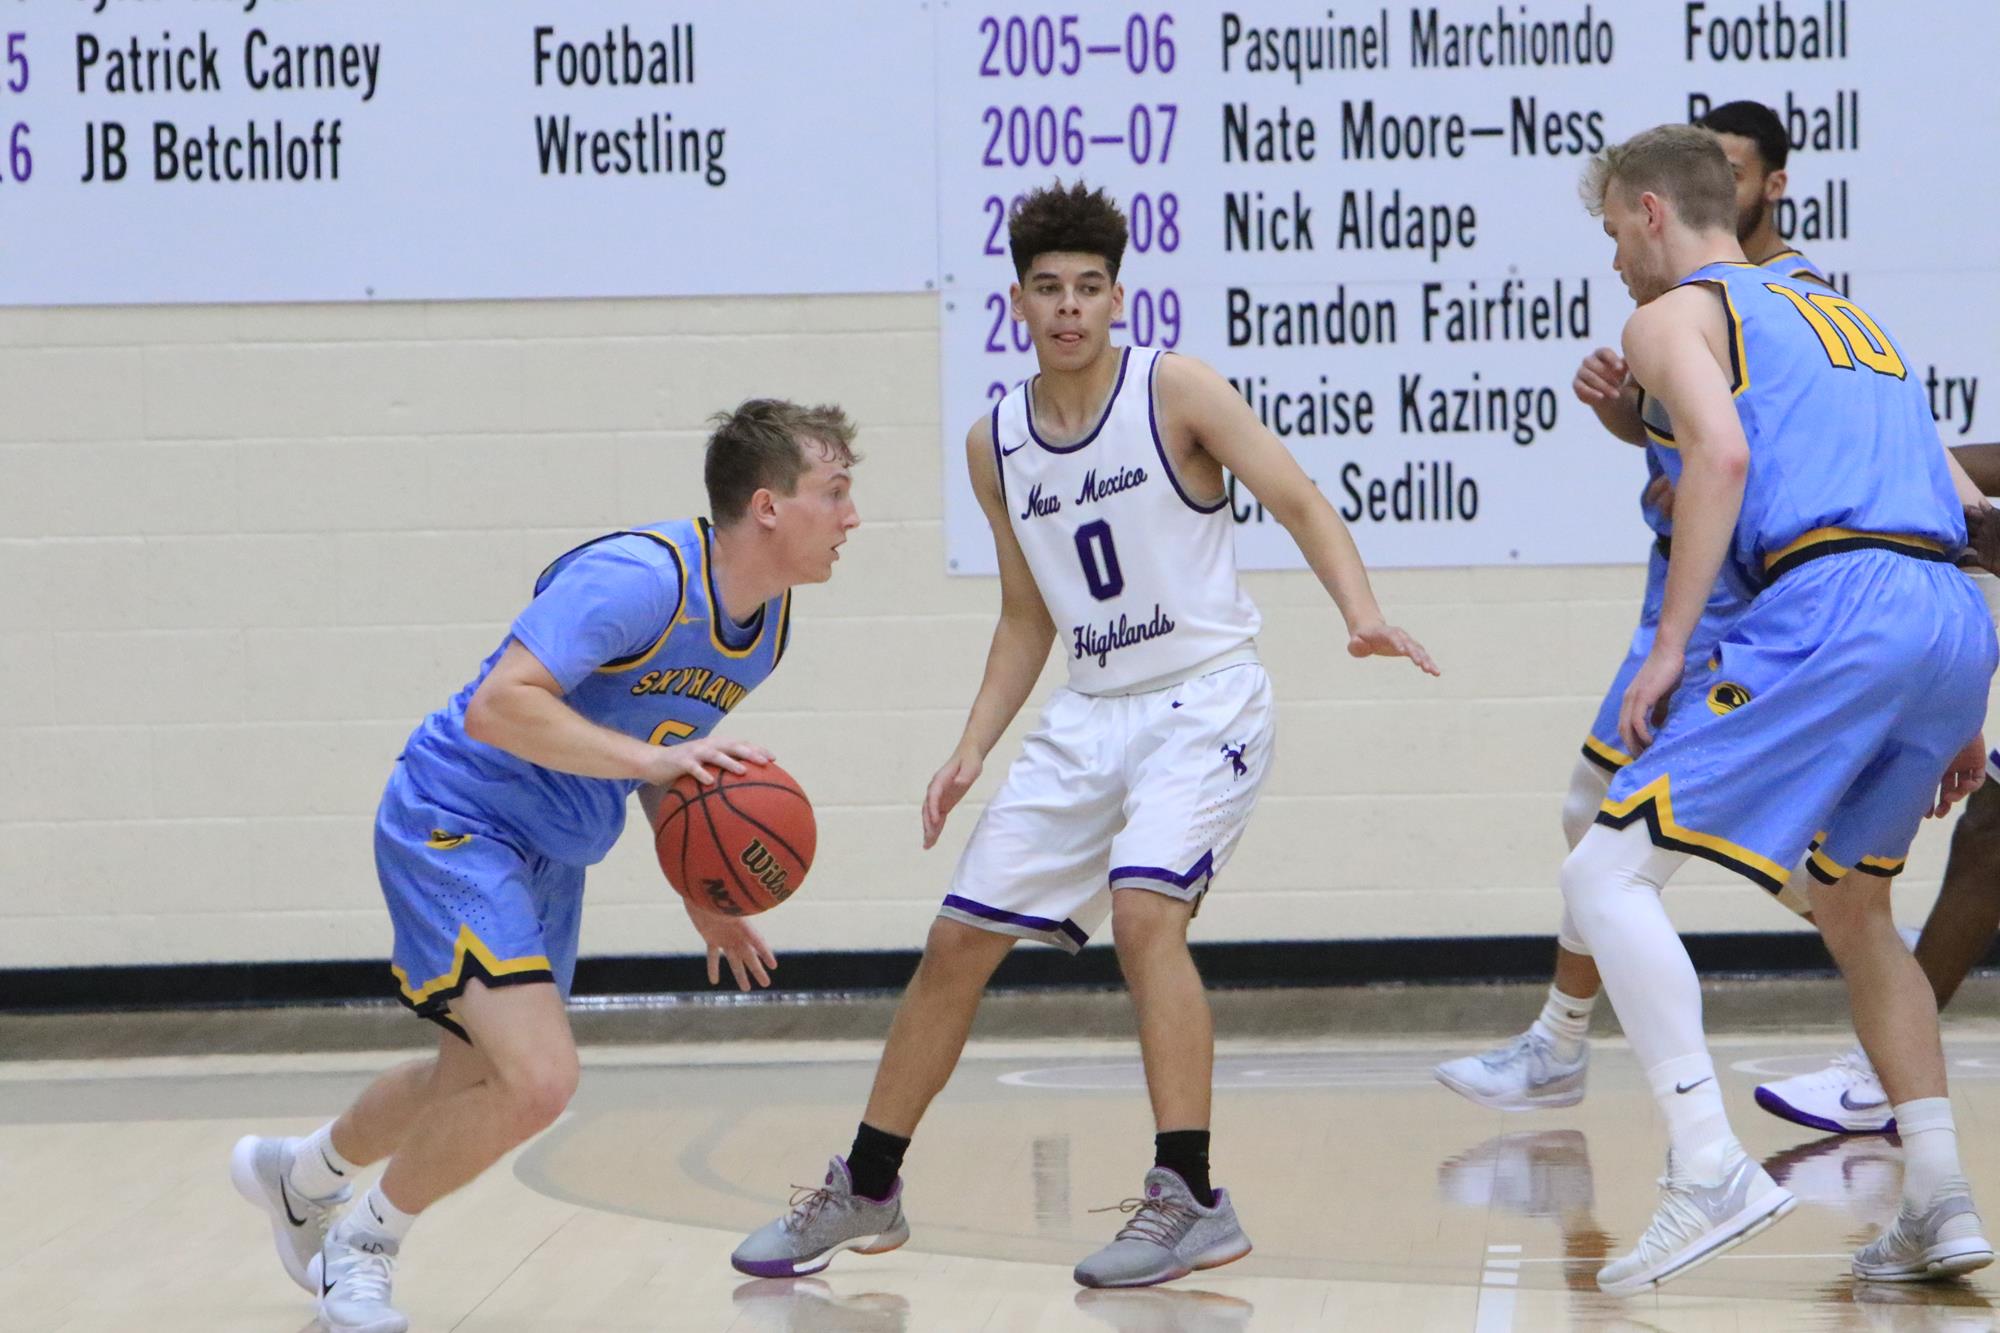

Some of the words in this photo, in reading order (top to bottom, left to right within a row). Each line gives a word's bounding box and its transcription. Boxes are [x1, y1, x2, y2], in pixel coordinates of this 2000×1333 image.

[75, 30, 221, 94] Patrick
[244, 27, 381, 102] Carney
[533, 23, 695, 87] Football
[979, 12, 1177, 77] 2005-06
[1221, 9, 1389, 86] Pasquinel
[1410, 4, 1614, 68] Marchiondo
[1685, 0, 1847, 62] Football
[80, 121, 128, 184] JB
[152, 118, 342, 183] Betchloff
[534, 112, 728, 188] Wrestling
[982, 103, 1179, 167] 2006-07
[1222, 102, 1317, 163] Nate
[1224, 190, 1315, 253] Nick
[1337, 188, 1477, 263] Aldape
[1226, 284, 1398, 348] Brandon
[1422, 277, 1591, 344] Fairfield
[1763, 282, 1908, 381] 10
[1399, 372, 1559, 447] Kazingo
[1021, 483, 1061, 520] New
[1075, 465, 1148, 505] Mexico
[1340, 461, 1479, 523] Sedillo
[1074, 518, 1125, 601] 0
[1073, 603, 1175, 668] Highlands
